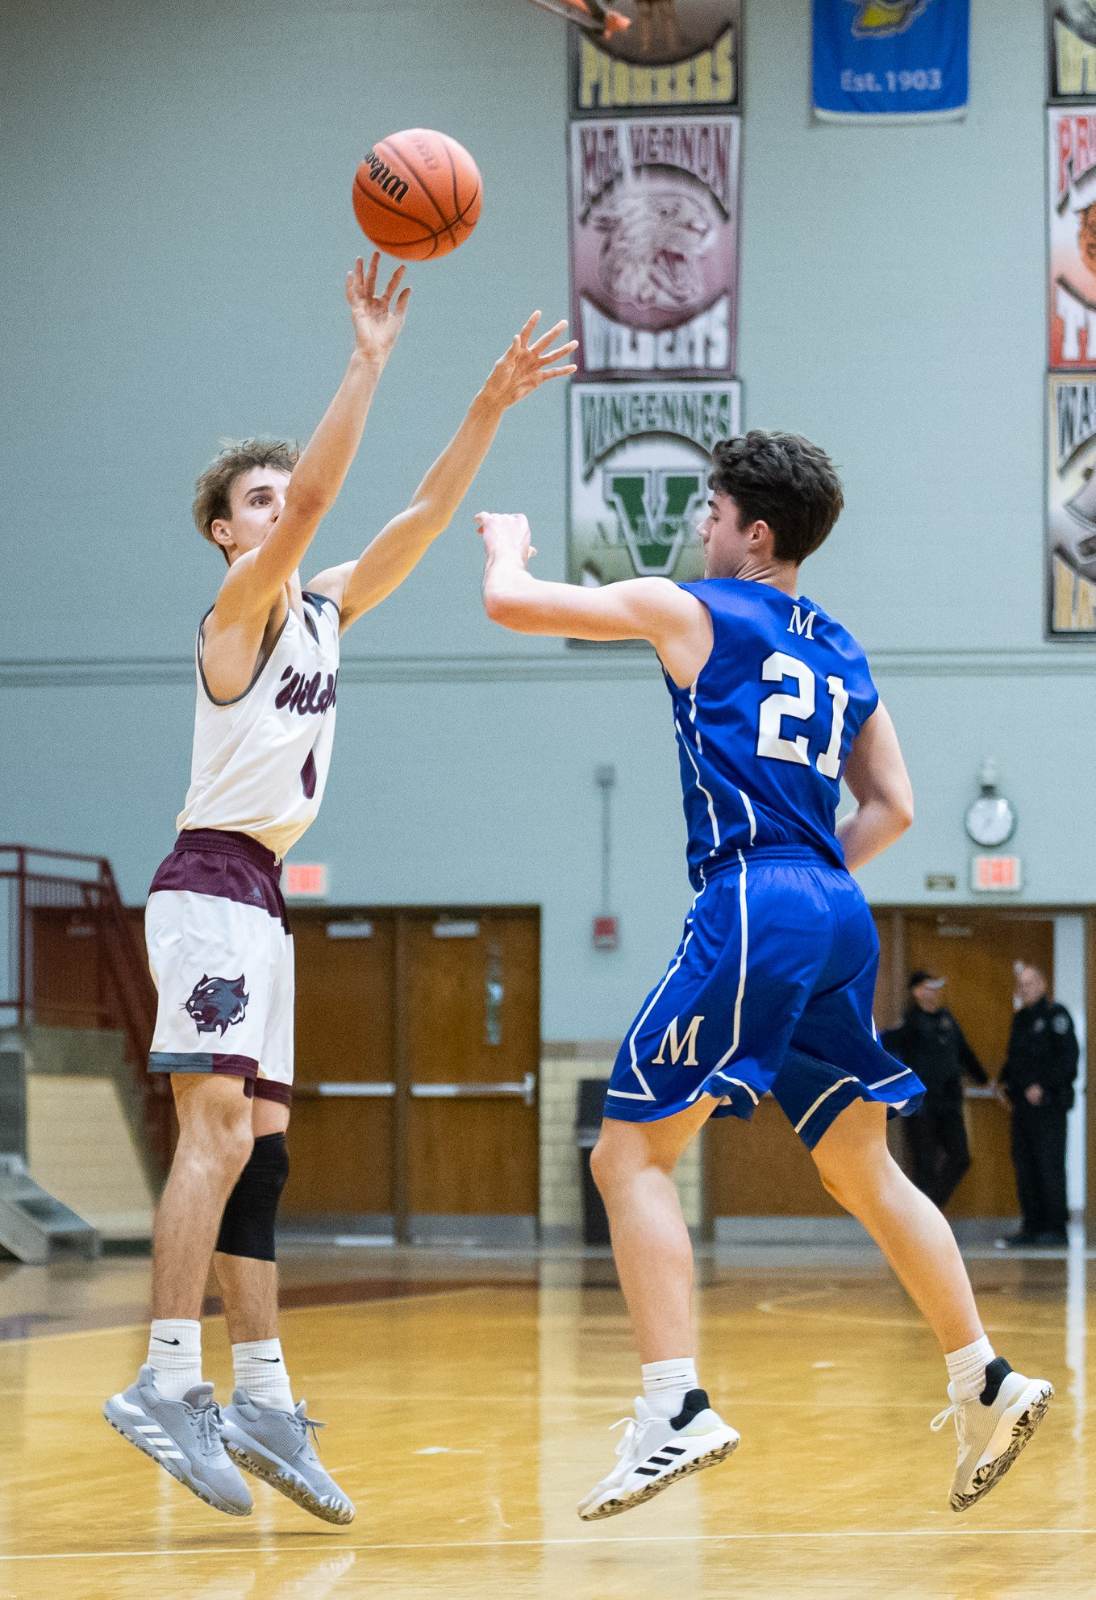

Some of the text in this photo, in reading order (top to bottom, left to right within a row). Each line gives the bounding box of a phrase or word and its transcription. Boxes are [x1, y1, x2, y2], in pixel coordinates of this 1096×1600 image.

[580, 29, 734, 107] PIONEERS
[840, 69, 942, 92] Est. 1903
[630, 124, 730, 200] VERNON
[580, 296, 729, 371] WILDCATS
[580, 392, 731, 466] VINCENNES
[787, 605, 817, 640] M
[275, 665, 337, 716] Wild
[756, 651, 850, 780] 21
[651, 1015, 705, 1066] M
